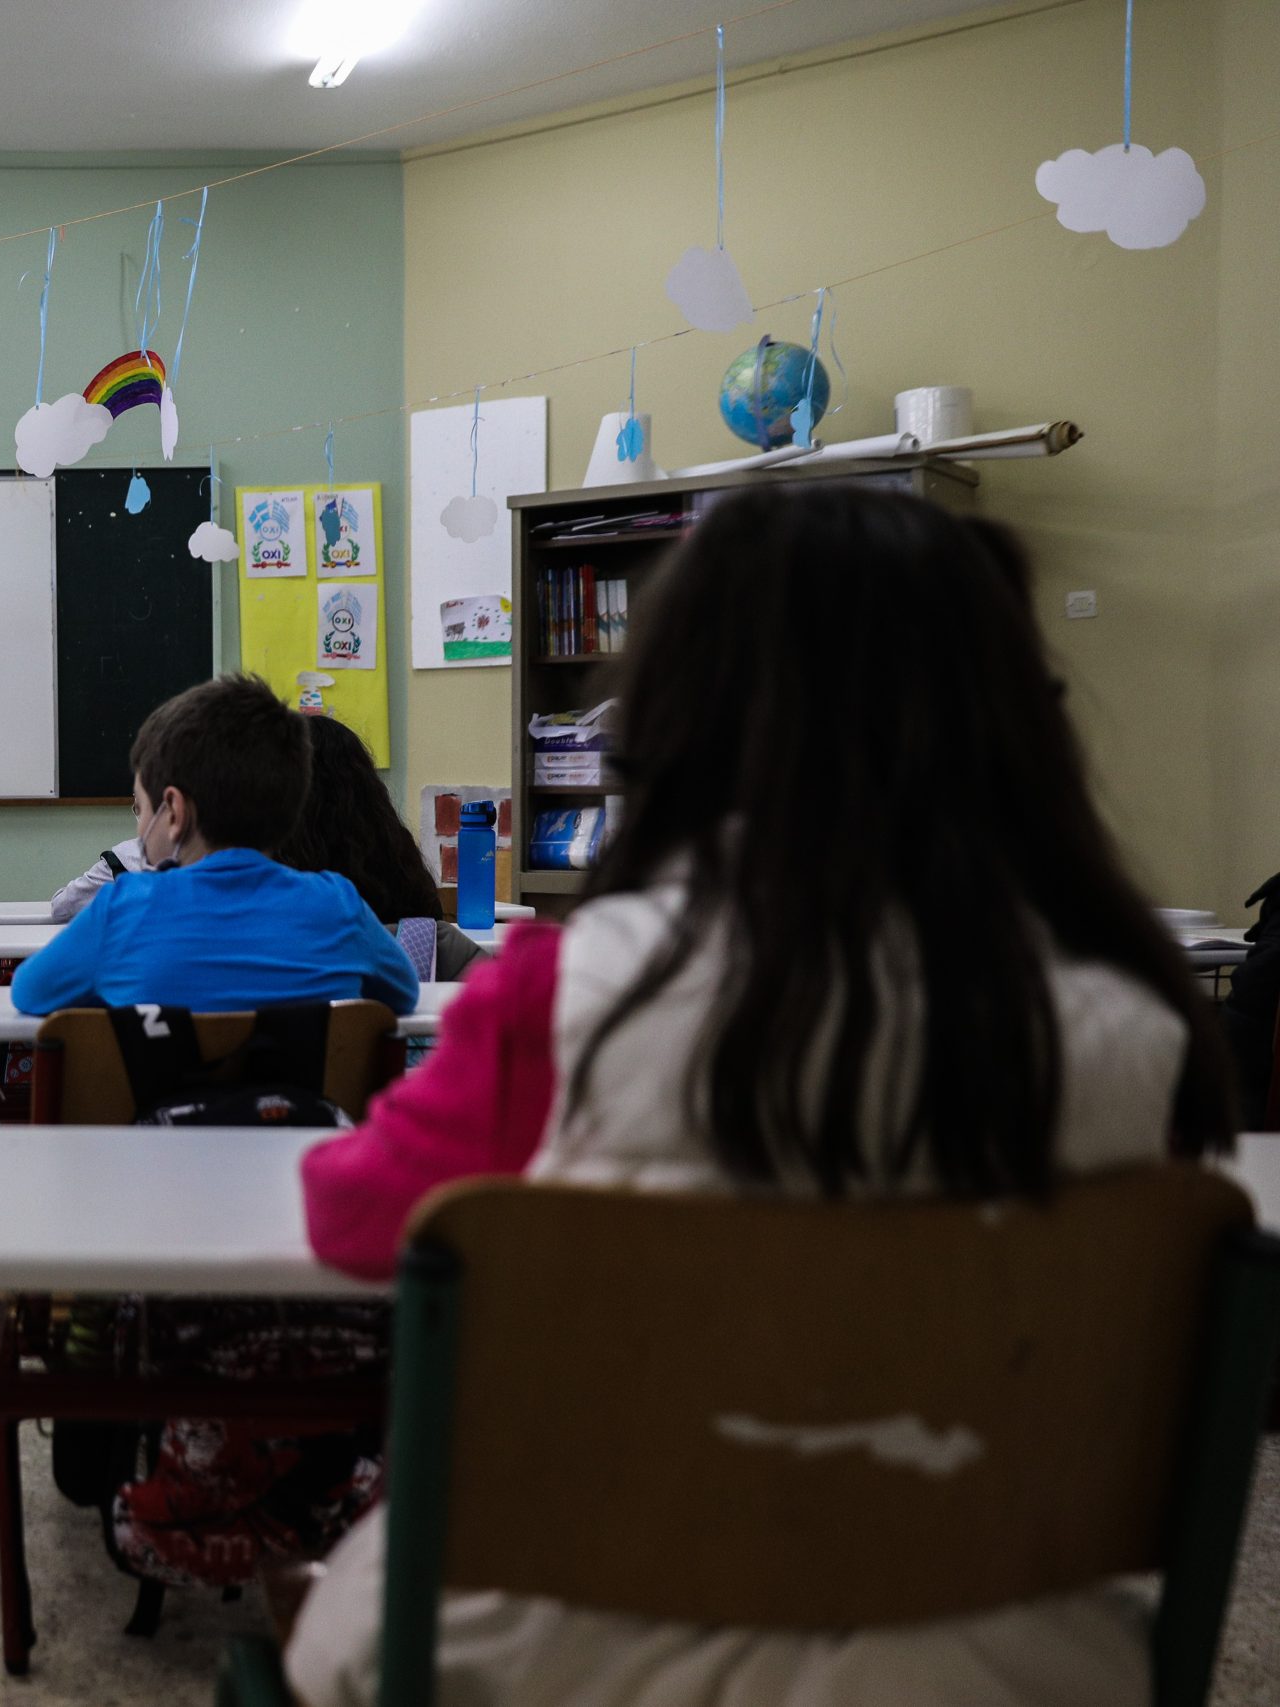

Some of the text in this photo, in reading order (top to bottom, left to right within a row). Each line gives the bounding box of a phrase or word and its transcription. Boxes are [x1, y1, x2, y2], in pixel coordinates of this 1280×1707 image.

[261, 548, 281, 560] ΟΧΙ
[331, 549, 351, 560] ΟΧΙ
[334, 617, 352, 625] ΟΧΙ
[333, 641, 352, 651] ΟΧΙ
